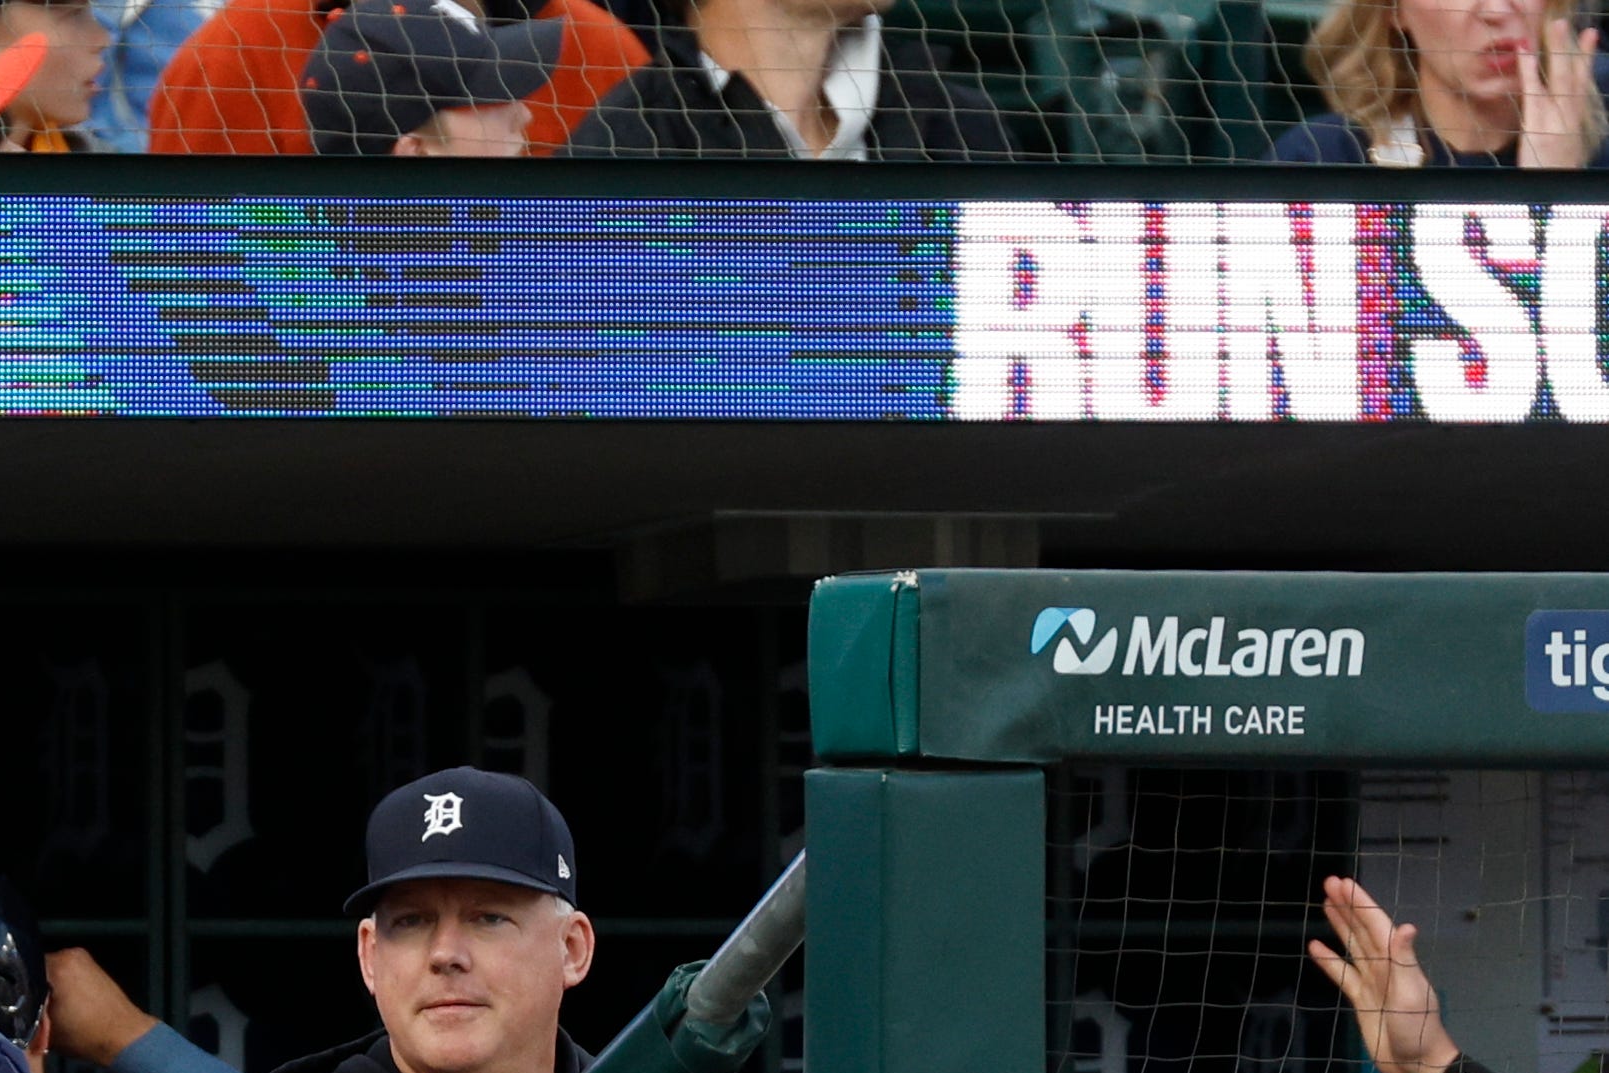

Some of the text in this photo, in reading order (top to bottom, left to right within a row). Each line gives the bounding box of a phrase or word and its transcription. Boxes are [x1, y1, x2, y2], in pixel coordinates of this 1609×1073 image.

[951, 202, 1358, 421] RUN
[1122, 616, 1366, 678] McLaren
[1094, 704, 1306, 735] HEALTH CARE
